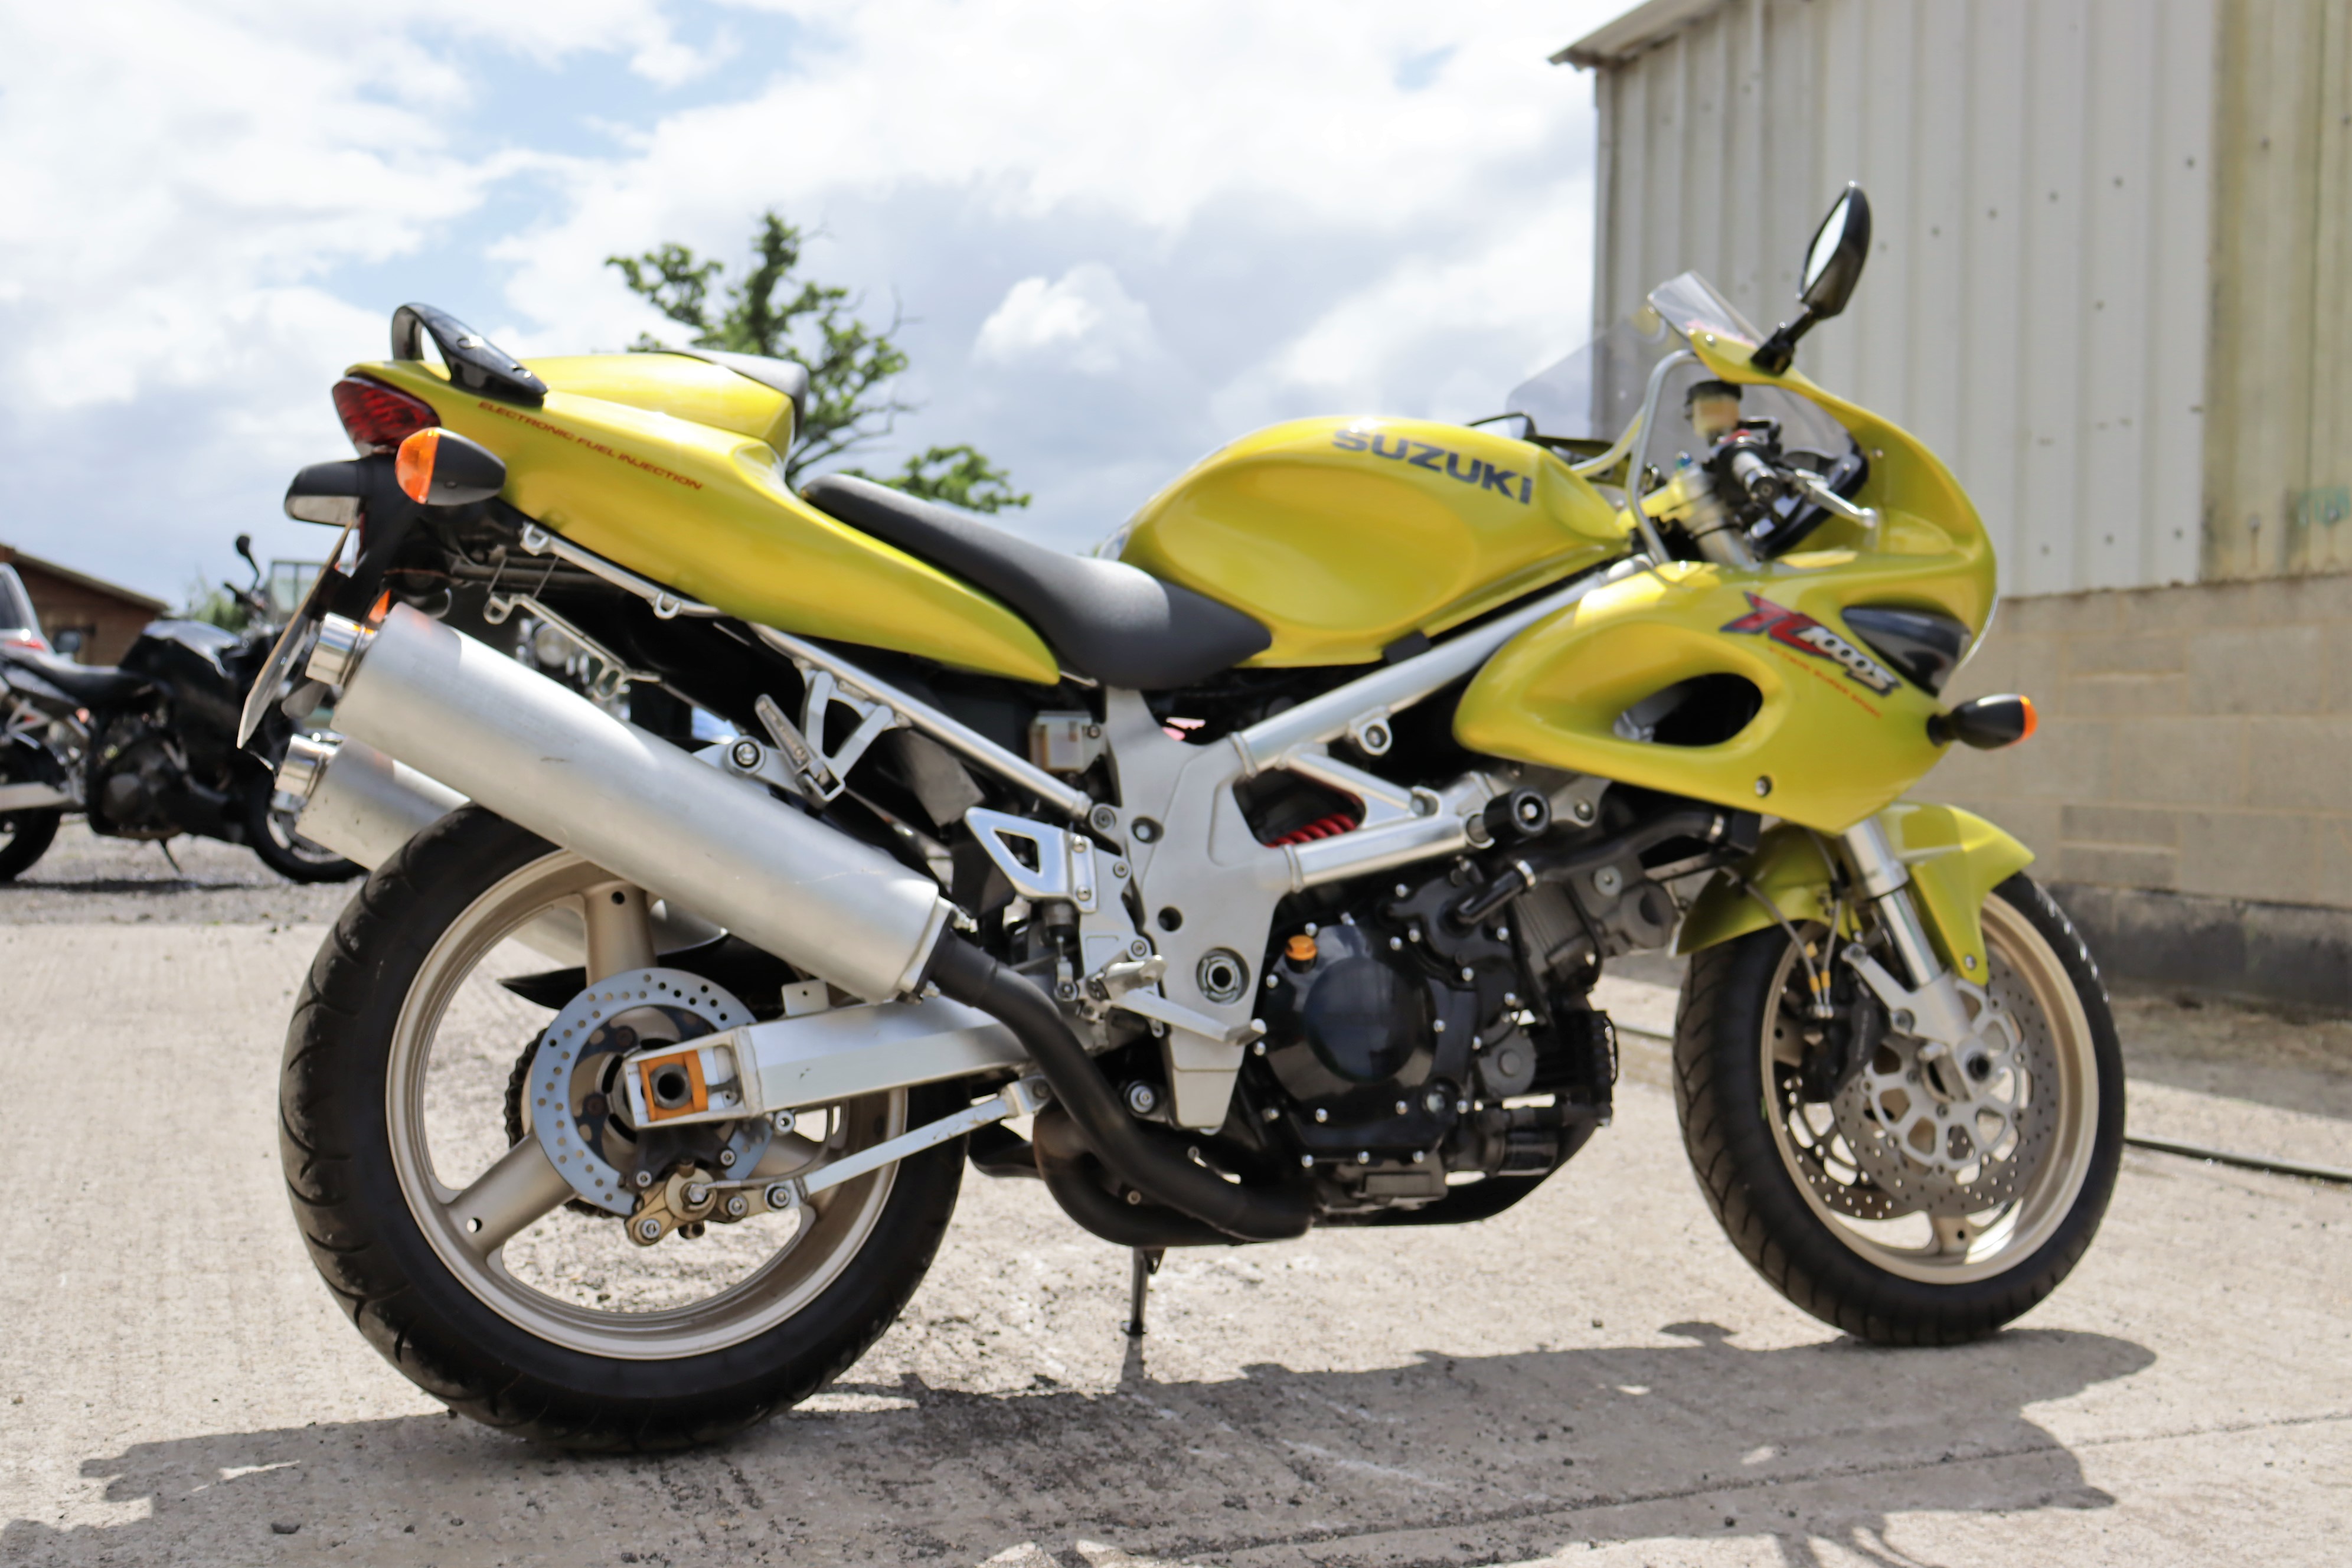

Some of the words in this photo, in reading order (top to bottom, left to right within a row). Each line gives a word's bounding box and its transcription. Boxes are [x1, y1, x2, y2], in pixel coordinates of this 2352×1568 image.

[478, 401, 574, 441] ELECTRONIC
[577, 437, 615, 458] FUEL
[618, 455, 703, 490] INJECTION
[1332, 430, 1532, 504] SUZUKI
